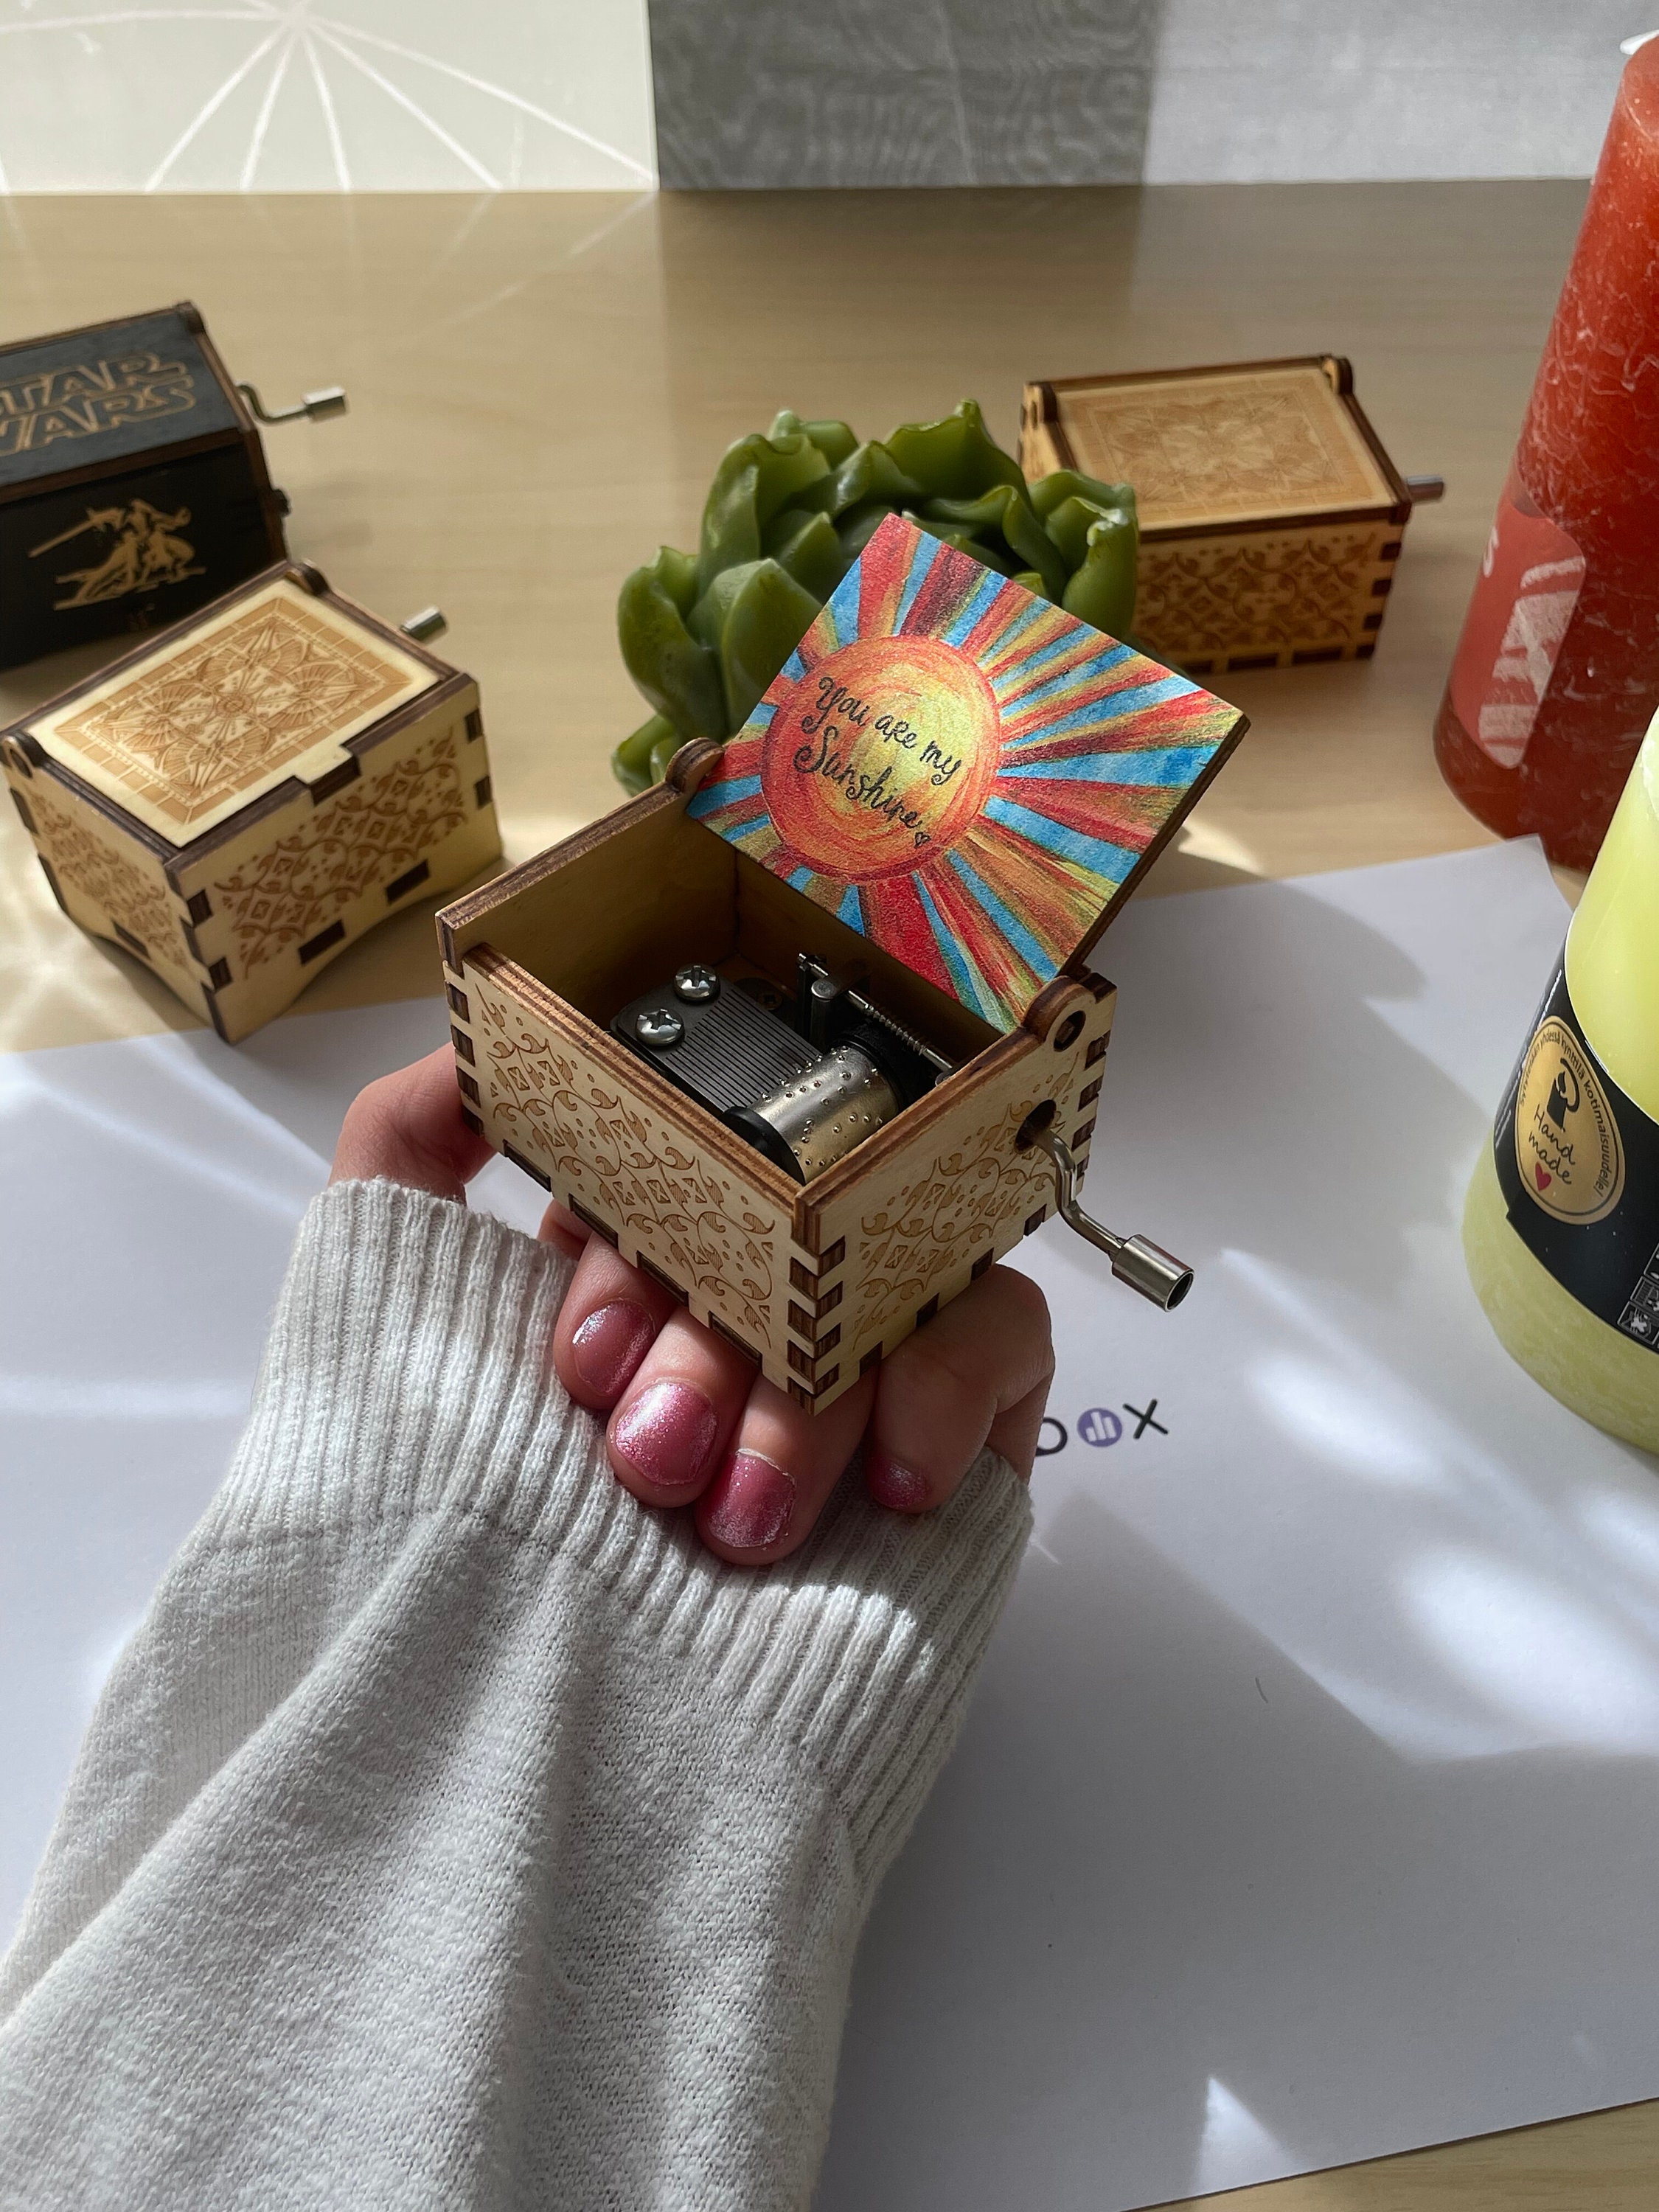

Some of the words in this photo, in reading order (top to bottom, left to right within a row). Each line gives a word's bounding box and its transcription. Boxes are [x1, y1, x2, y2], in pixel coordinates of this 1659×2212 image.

[0, 350, 187, 417] TAR
[801, 677, 872, 734] You
[874, 714, 917, 749] are
[919, 740, 961, 787] my
[793, 725, 923, 830] Sunshine
[1528, 1132, 1572, 1185] made
[1534, 1104, 1576, 1165] Hand
